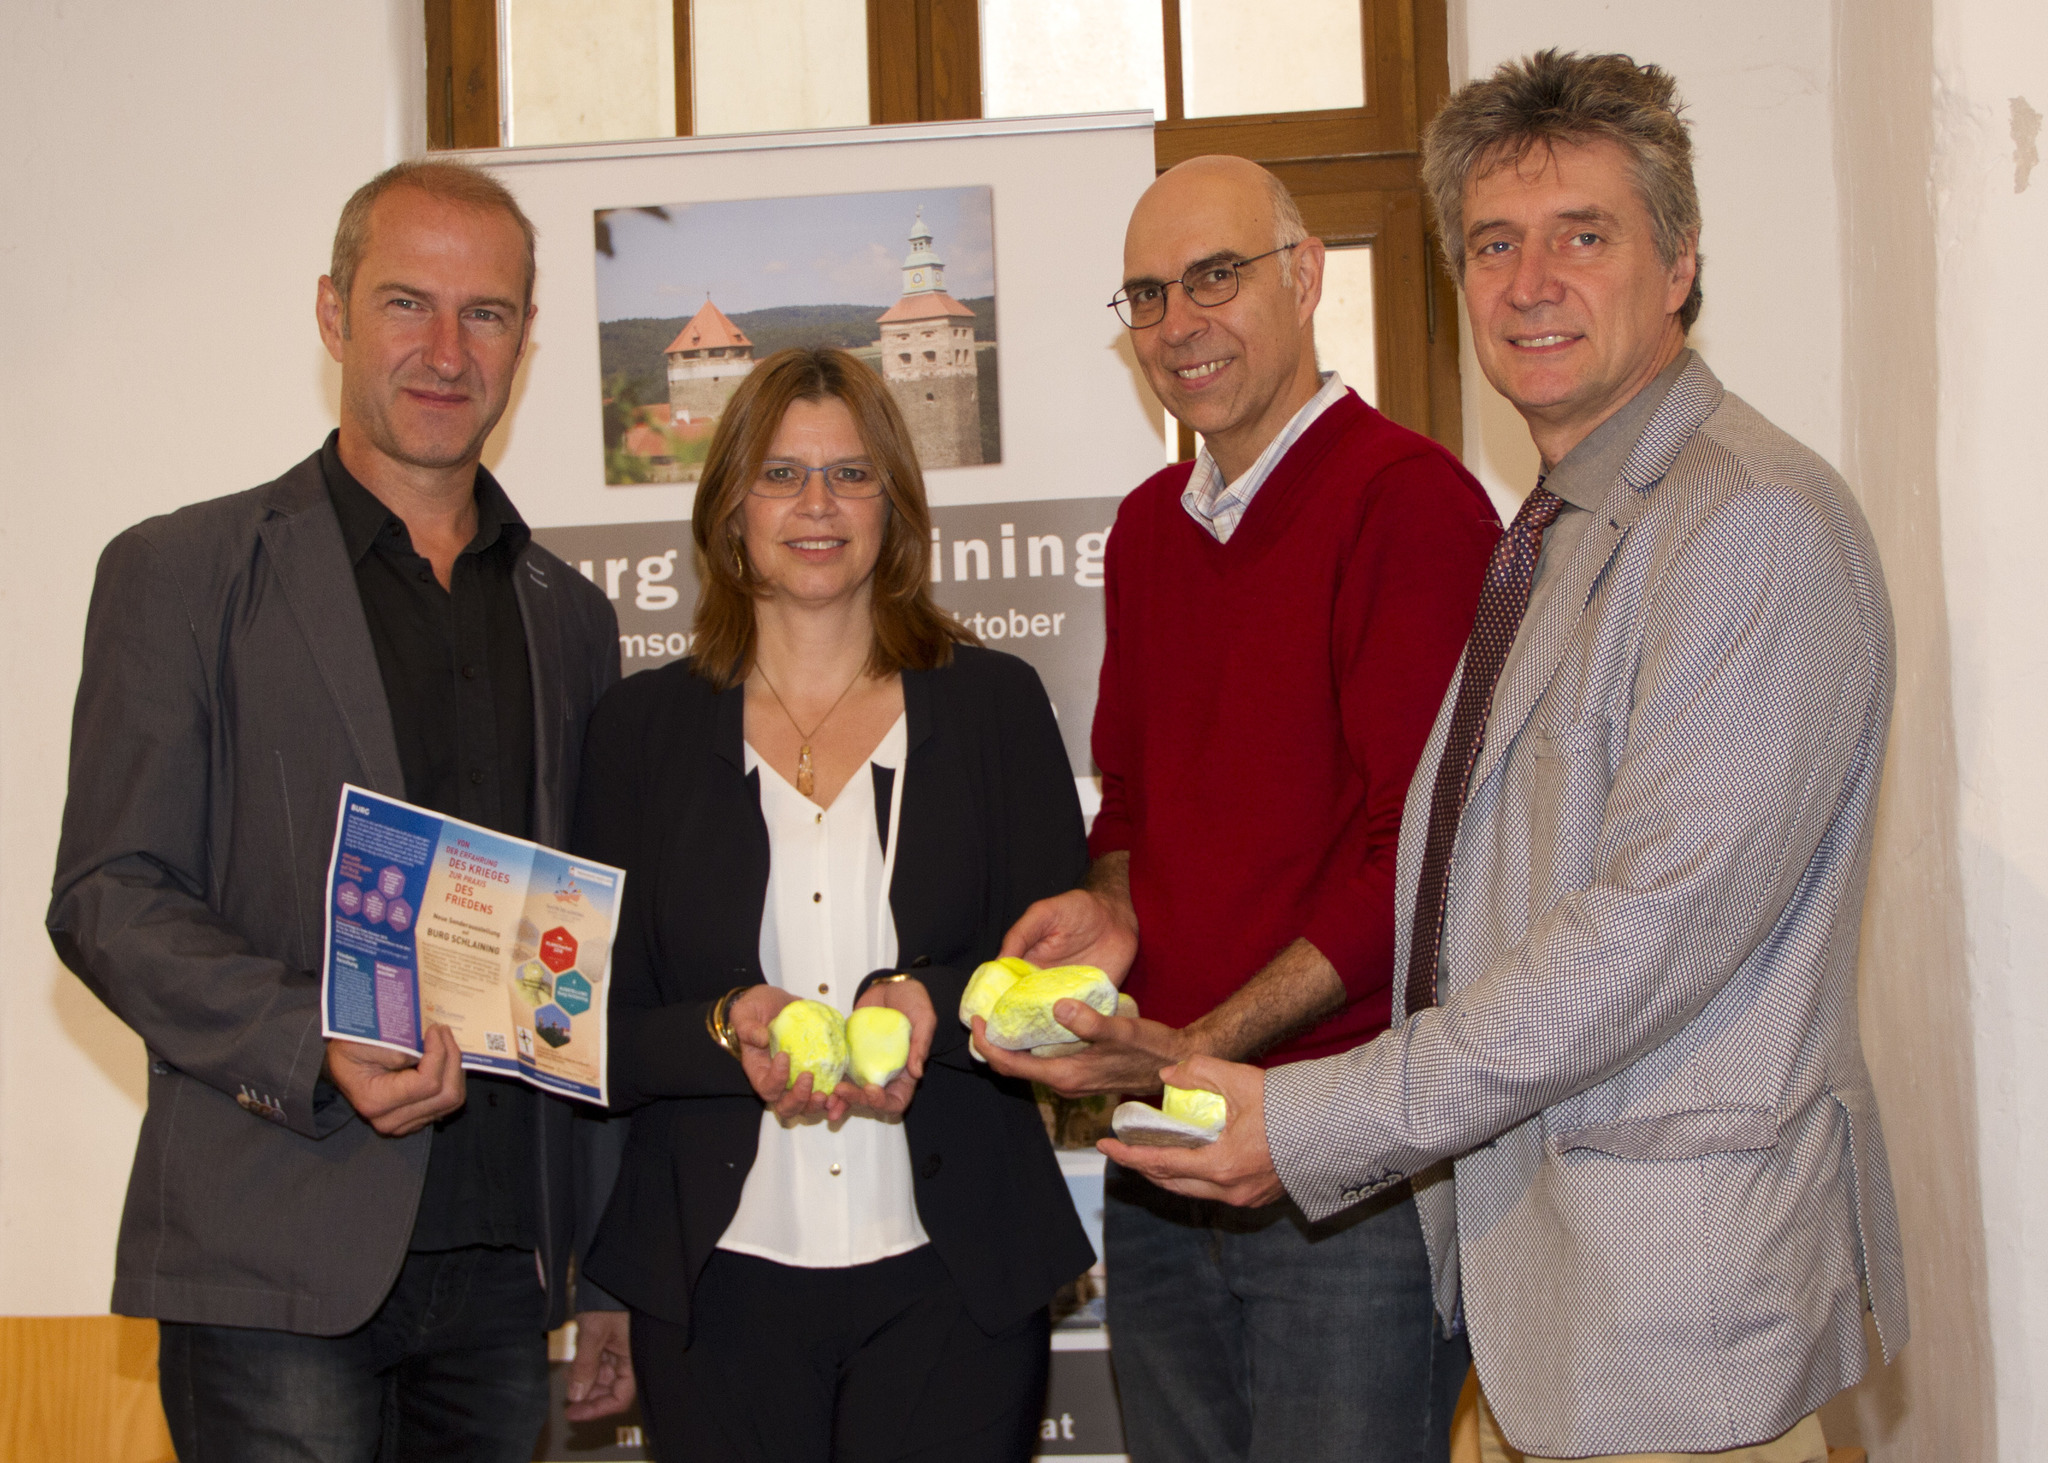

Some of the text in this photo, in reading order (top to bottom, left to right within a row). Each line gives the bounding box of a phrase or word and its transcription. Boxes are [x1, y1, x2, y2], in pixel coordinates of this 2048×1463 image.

[457, 838, 471, 849] VON
[446, 845, 498, 868] DER ERFAHRUNG
[448, 870, 487, 888] ZUR PRAXIS
[449, 857, 511, 884] DES KRIEGES
[455, 883, 474, 897] DES
[445, 893, 494, 915] FRIEDENS
[433, 912, 448, 922] Neue
[427, 927, 450, 941] BURG
[451, 934, 500, 955] SCHLAINING
